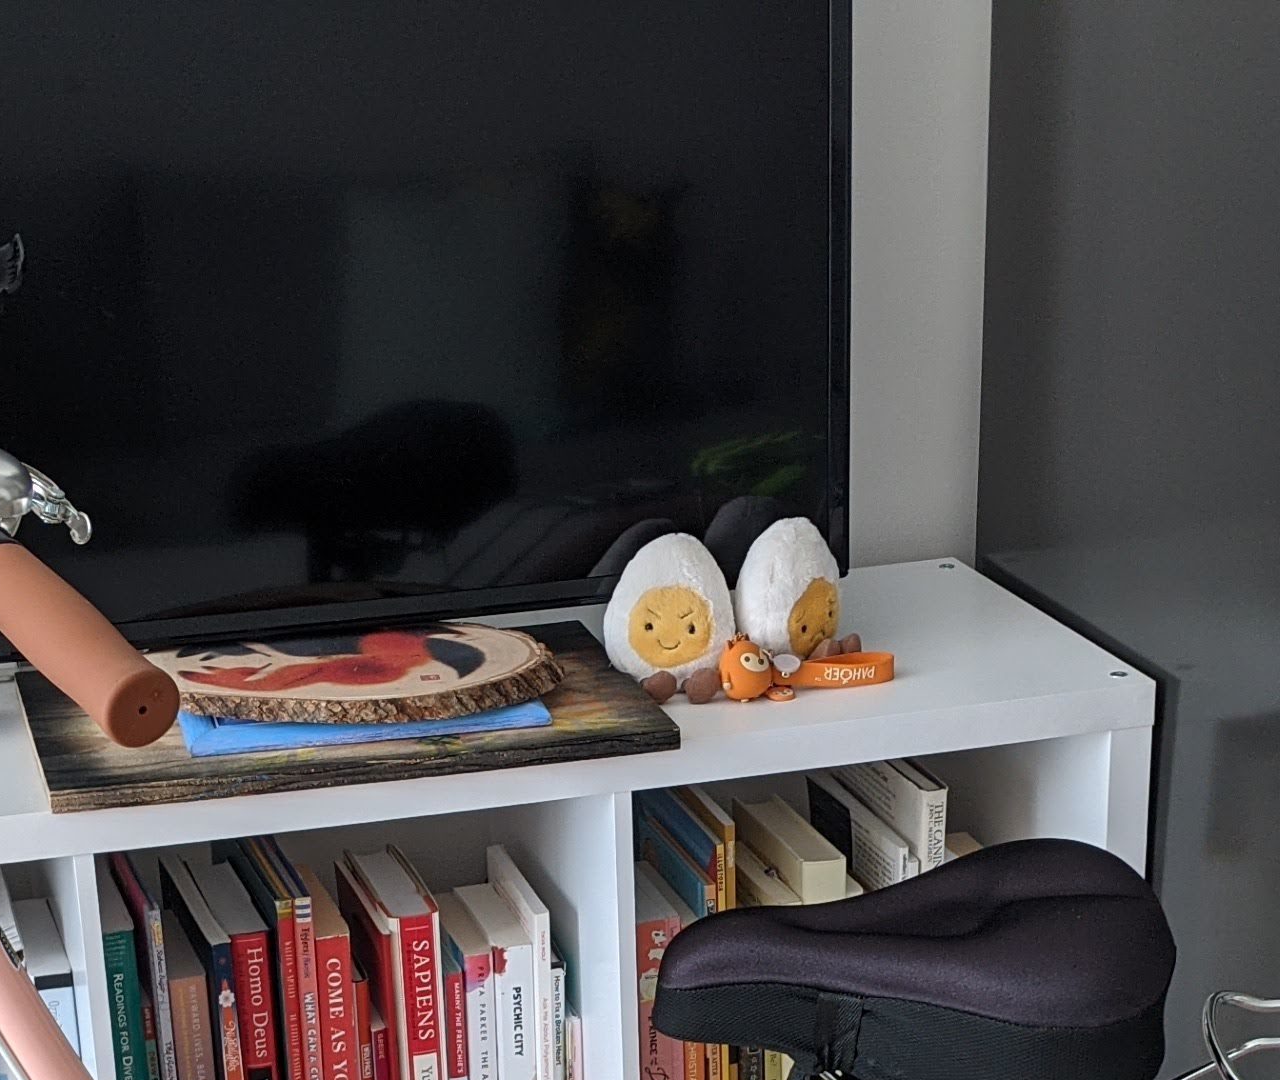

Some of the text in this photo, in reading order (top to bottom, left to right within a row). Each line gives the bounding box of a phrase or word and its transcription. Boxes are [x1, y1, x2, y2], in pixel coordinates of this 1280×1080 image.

[934, 801, 945, 827] THE
[246, 946, 269, 1059] Homo Deus
[325, 957, 345, 1019] COME
[412, 939, 435, 1041] SAPIENS
[453, 982, 461, 1008] MANNY
[112, 972, 128, 1030] READINGS
[120, 1031, 130, 1051] FOR
[304, 991, 316, 1026] WHAT
[479, 1002, 488, 1042] PARKER
[512, 986, 524, 1056] PSYCHIC CITY
[307, 1028, 317, 1051] CAN
[330, 1026, 347, 1053] AS
